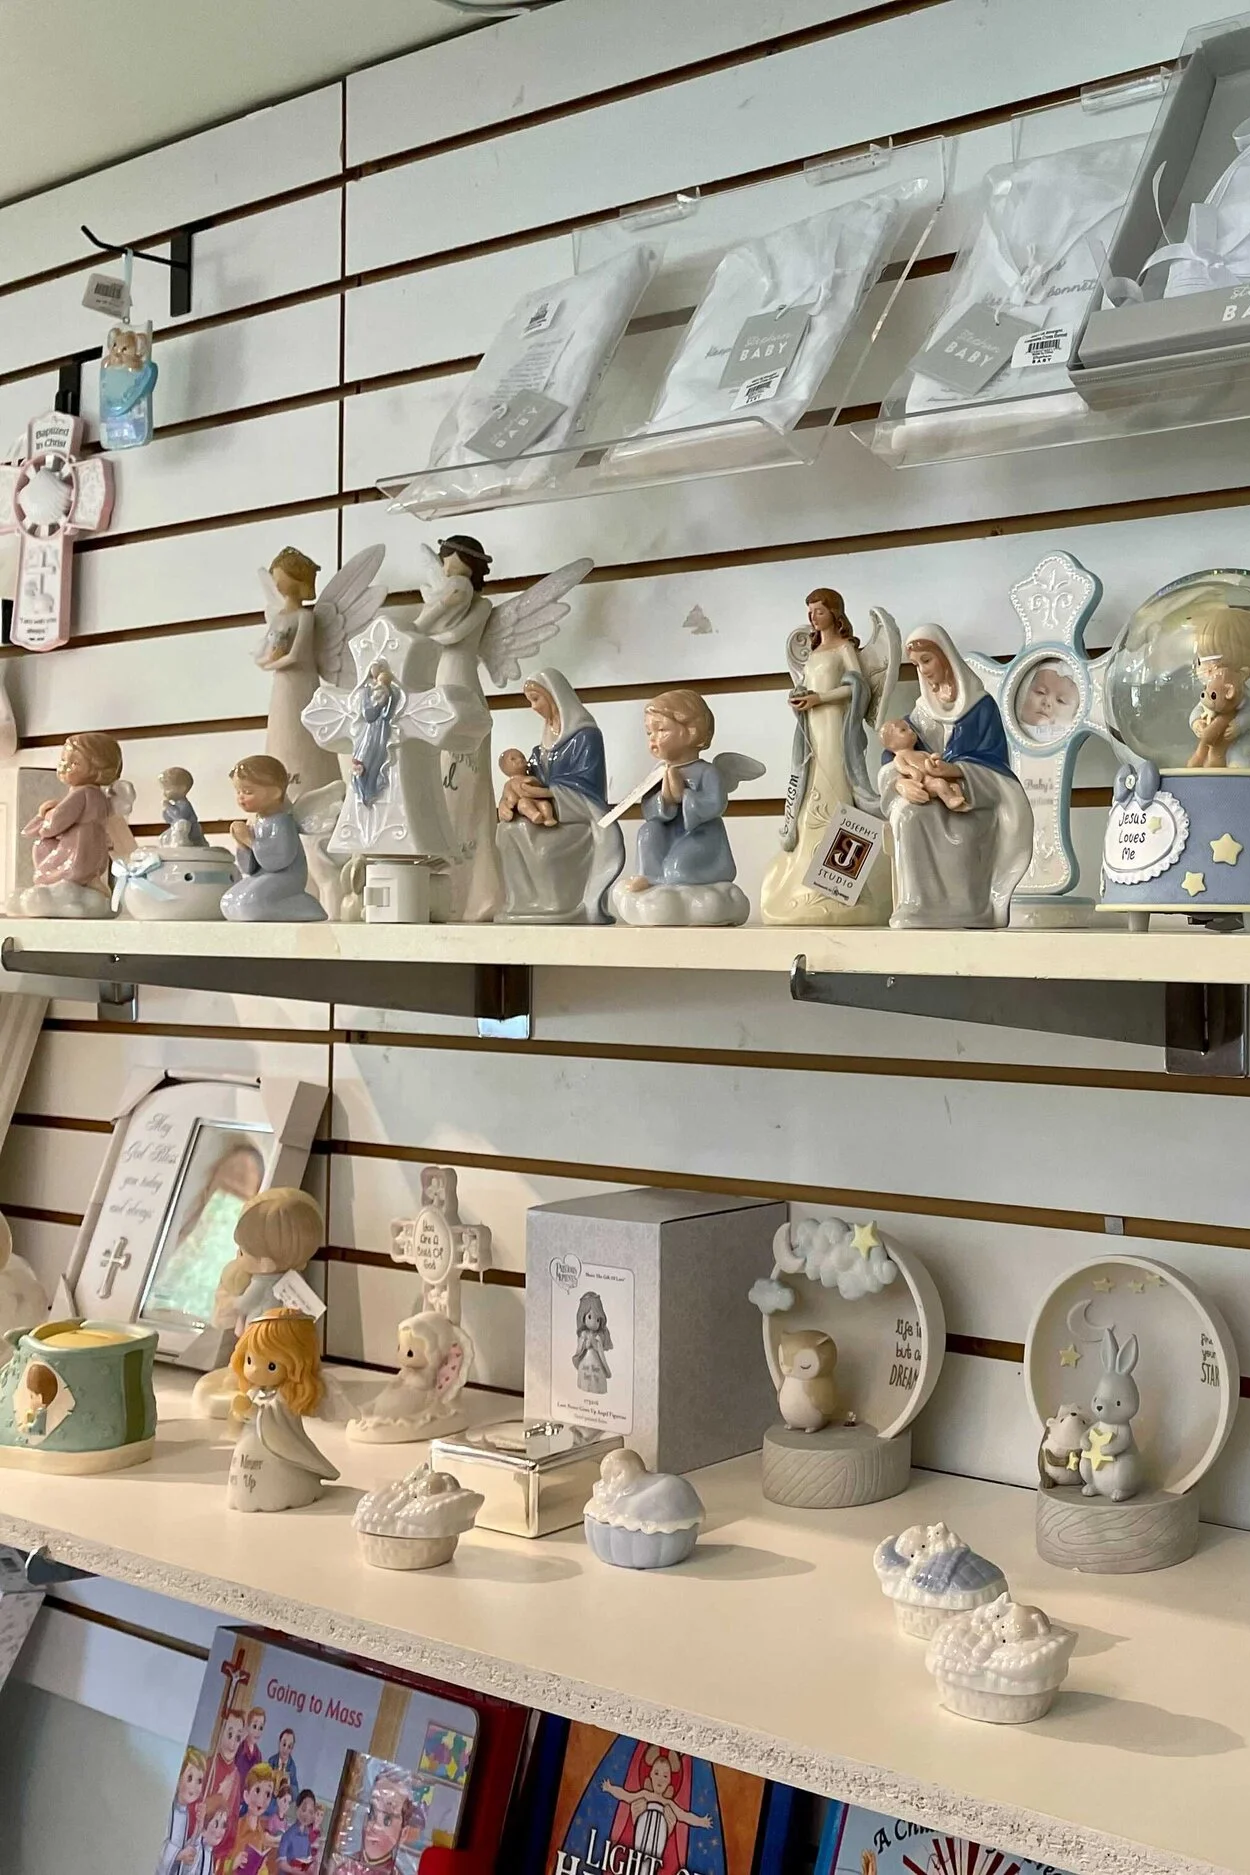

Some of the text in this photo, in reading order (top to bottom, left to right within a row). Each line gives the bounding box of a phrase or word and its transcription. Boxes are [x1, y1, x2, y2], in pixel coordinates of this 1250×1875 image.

[739, 341, 788, 362] BABY
[944, 341, 994, 367] BABY
[36, 428, 69, 439] Baptized
[496, 407, 538, 449] BABY
[44, 438, 66, 448] Christ
[840, 818, 879, 841] JOSEPH'S
[1118, 812, 1147, 827] Jesus
[1118, 831, 1146, 844] Loves
[1122, 847, 1136, 860] Me
[818, 868, 854, 889] STUDIO
[150, 1143, 179, 1165] Bless
[895, 1341, 912, 1360] but
[1200, 1362, 1220, 1387] STAR
[267, 1678, 363, 1728] Going to Mass
[873, 1826, 892, 1855] A
[585, 1828, 664, 1875] LIGHT
